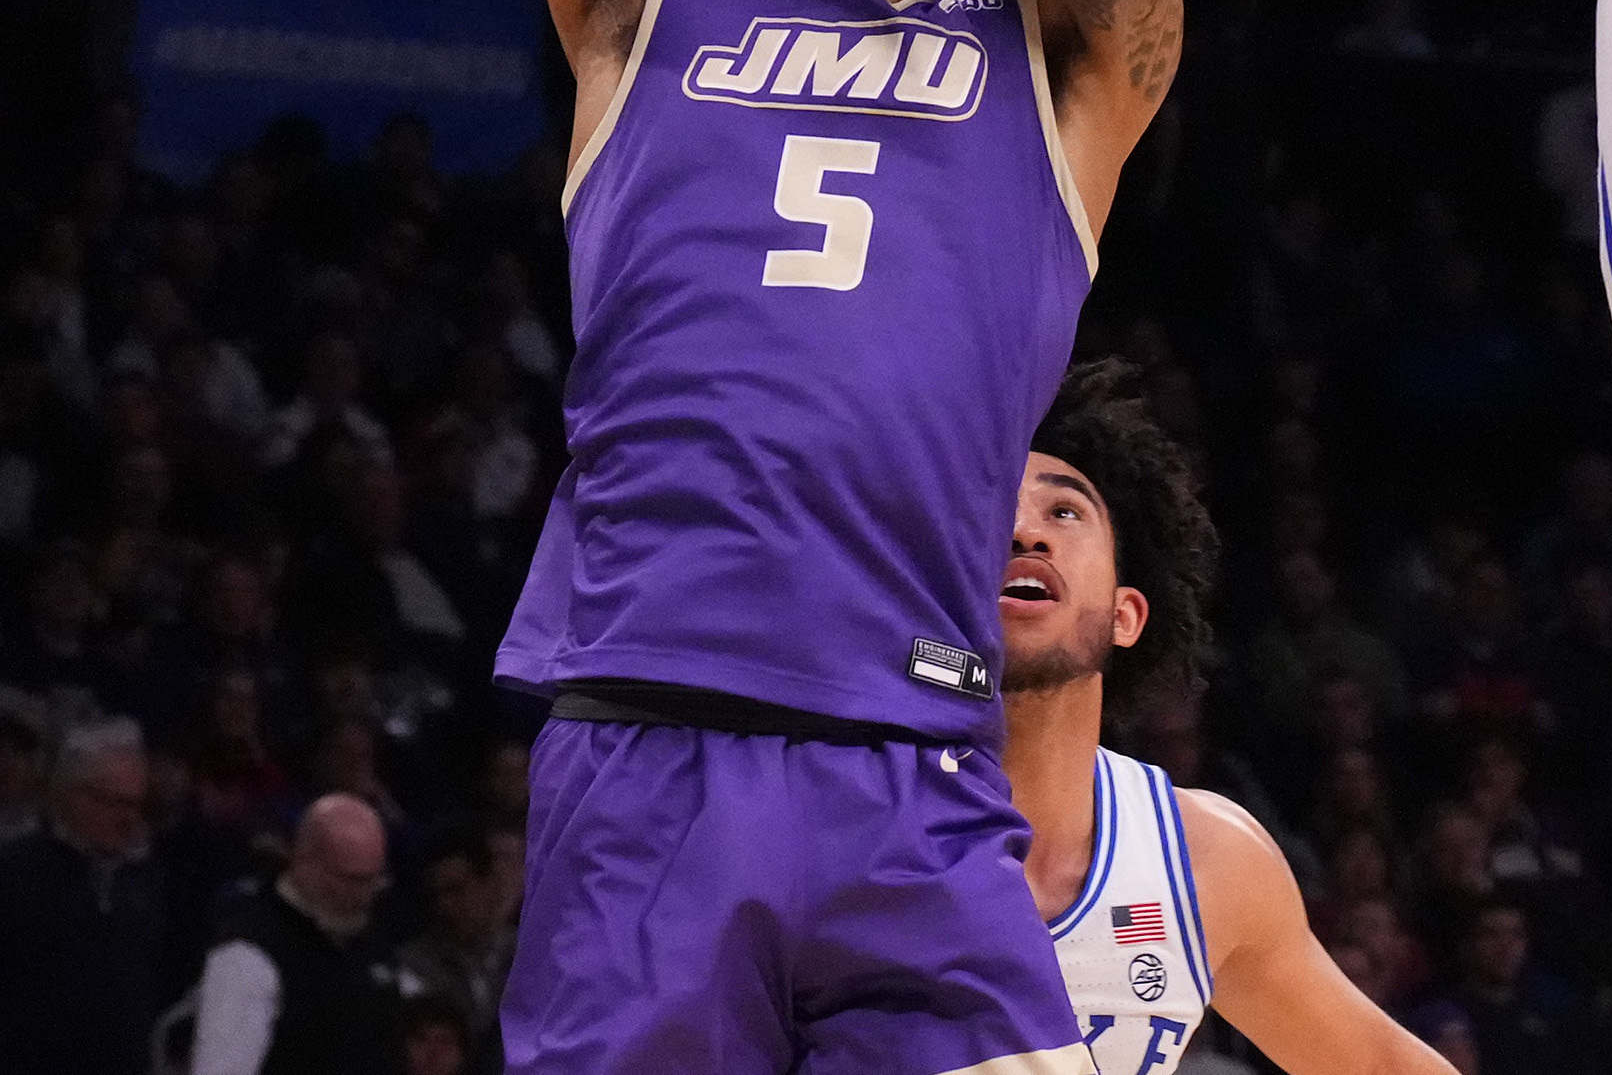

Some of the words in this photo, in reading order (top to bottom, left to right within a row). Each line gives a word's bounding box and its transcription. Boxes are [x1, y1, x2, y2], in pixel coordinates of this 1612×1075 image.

[696, 29, 982, 108] JMU
[762, 135, 881, 291] 5
[972, 666, 986, 686] M
